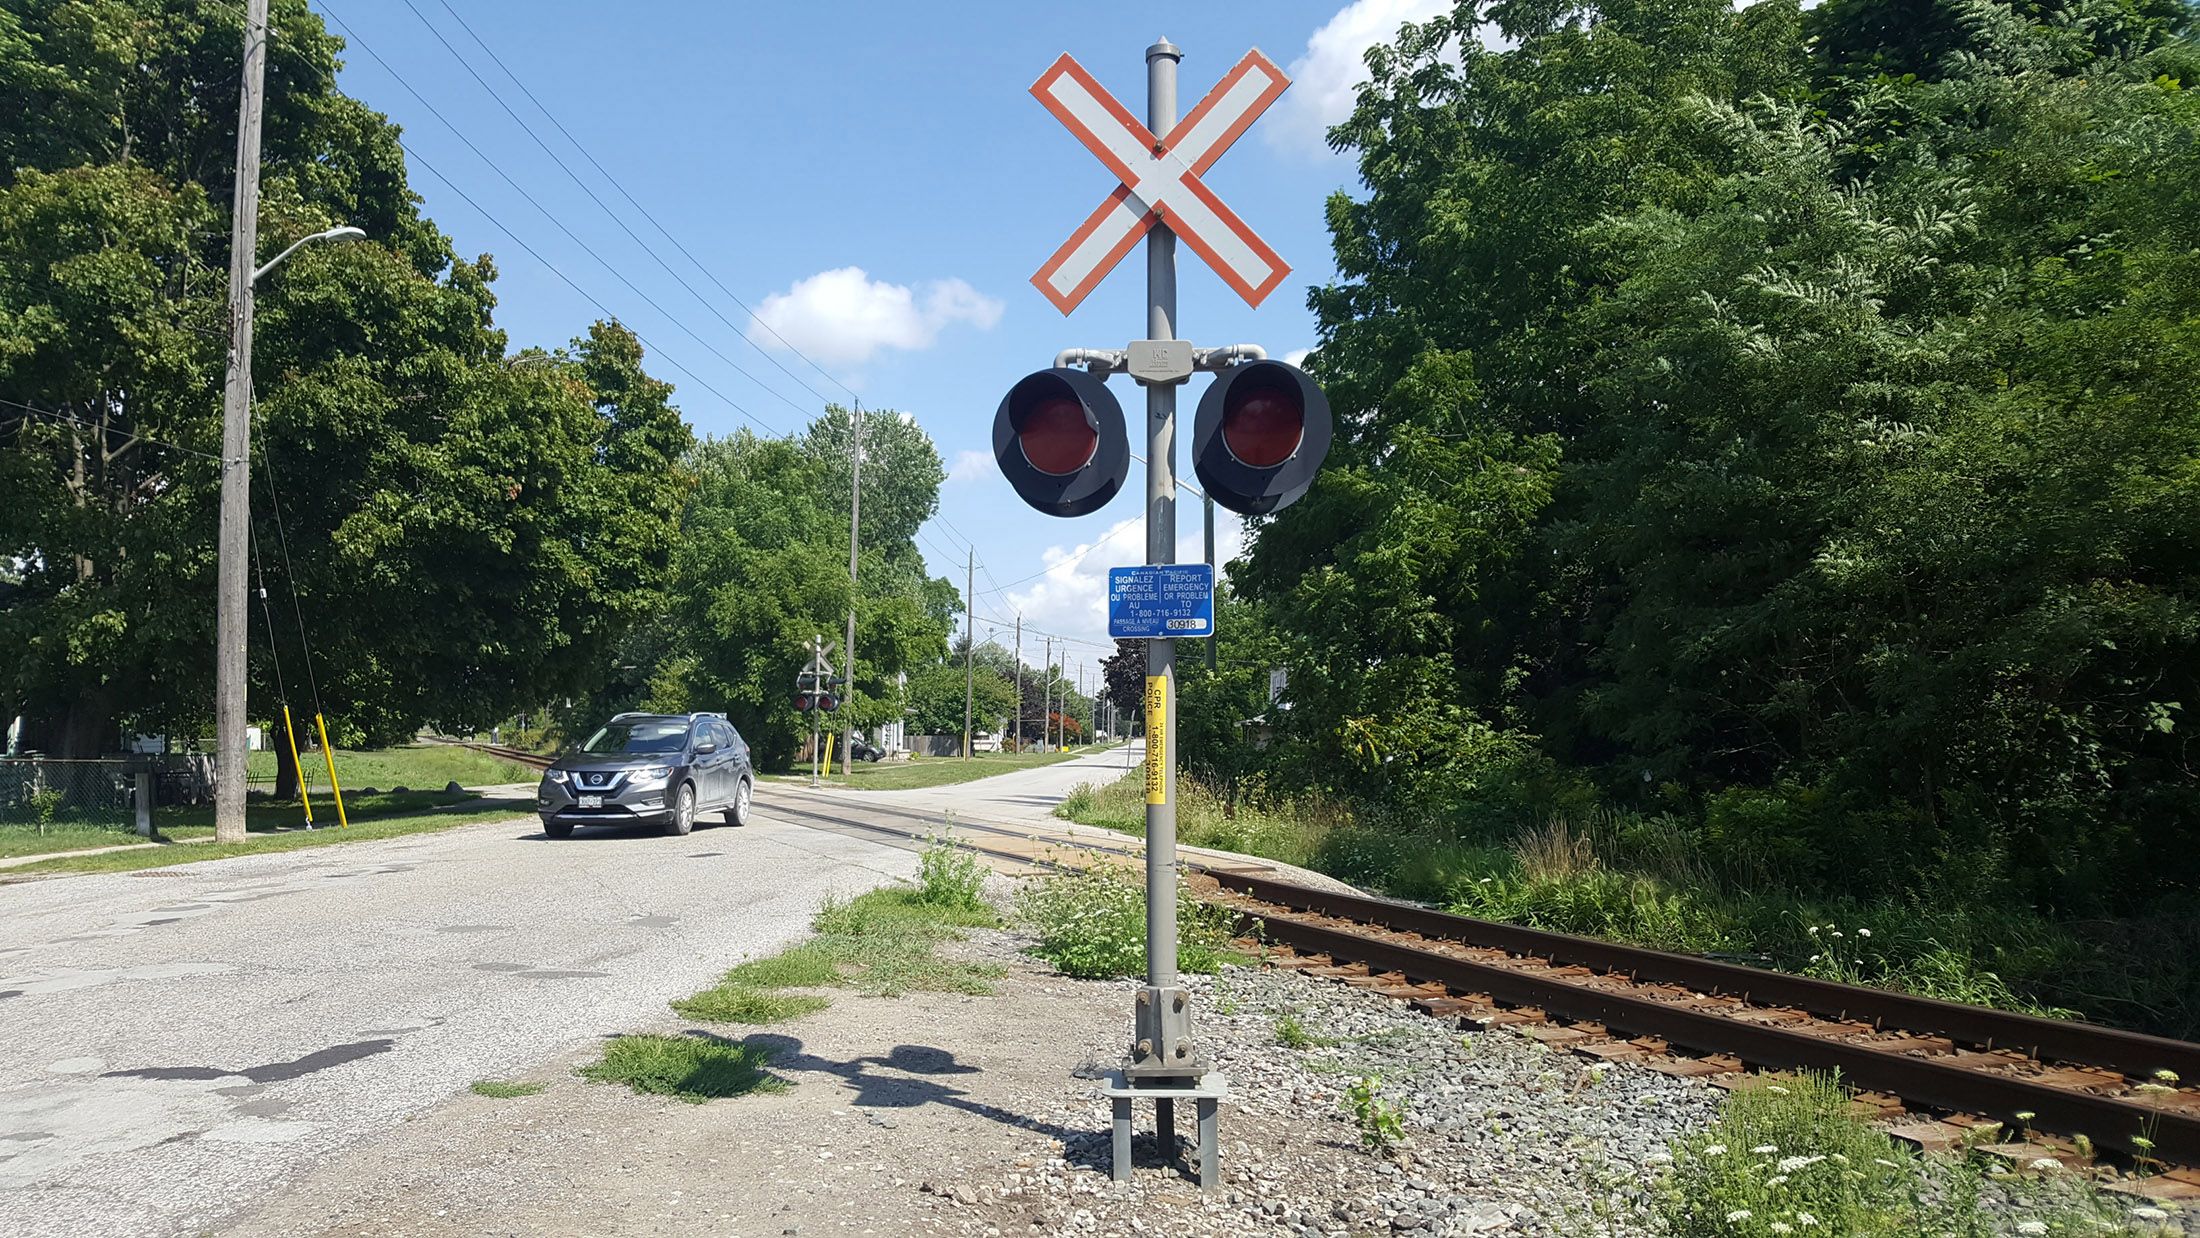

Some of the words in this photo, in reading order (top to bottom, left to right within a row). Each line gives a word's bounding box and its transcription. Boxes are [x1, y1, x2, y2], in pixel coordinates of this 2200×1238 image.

[1115, 576, 1154, 584] SIGNALEZ
[1170, 575, 1202, 583] REPORT
[1116, 585, 1154, 593] URGENCE
[1164, 584, 1209, 592] EMERGENCY
[1177, 592, 1209, 600] PROBLEM
[1168, 620, 1197, 629] 30918
[1154, 689, 1162, 709] CPR
[1151, 726, 1159, 791] 1-800-716-9132
